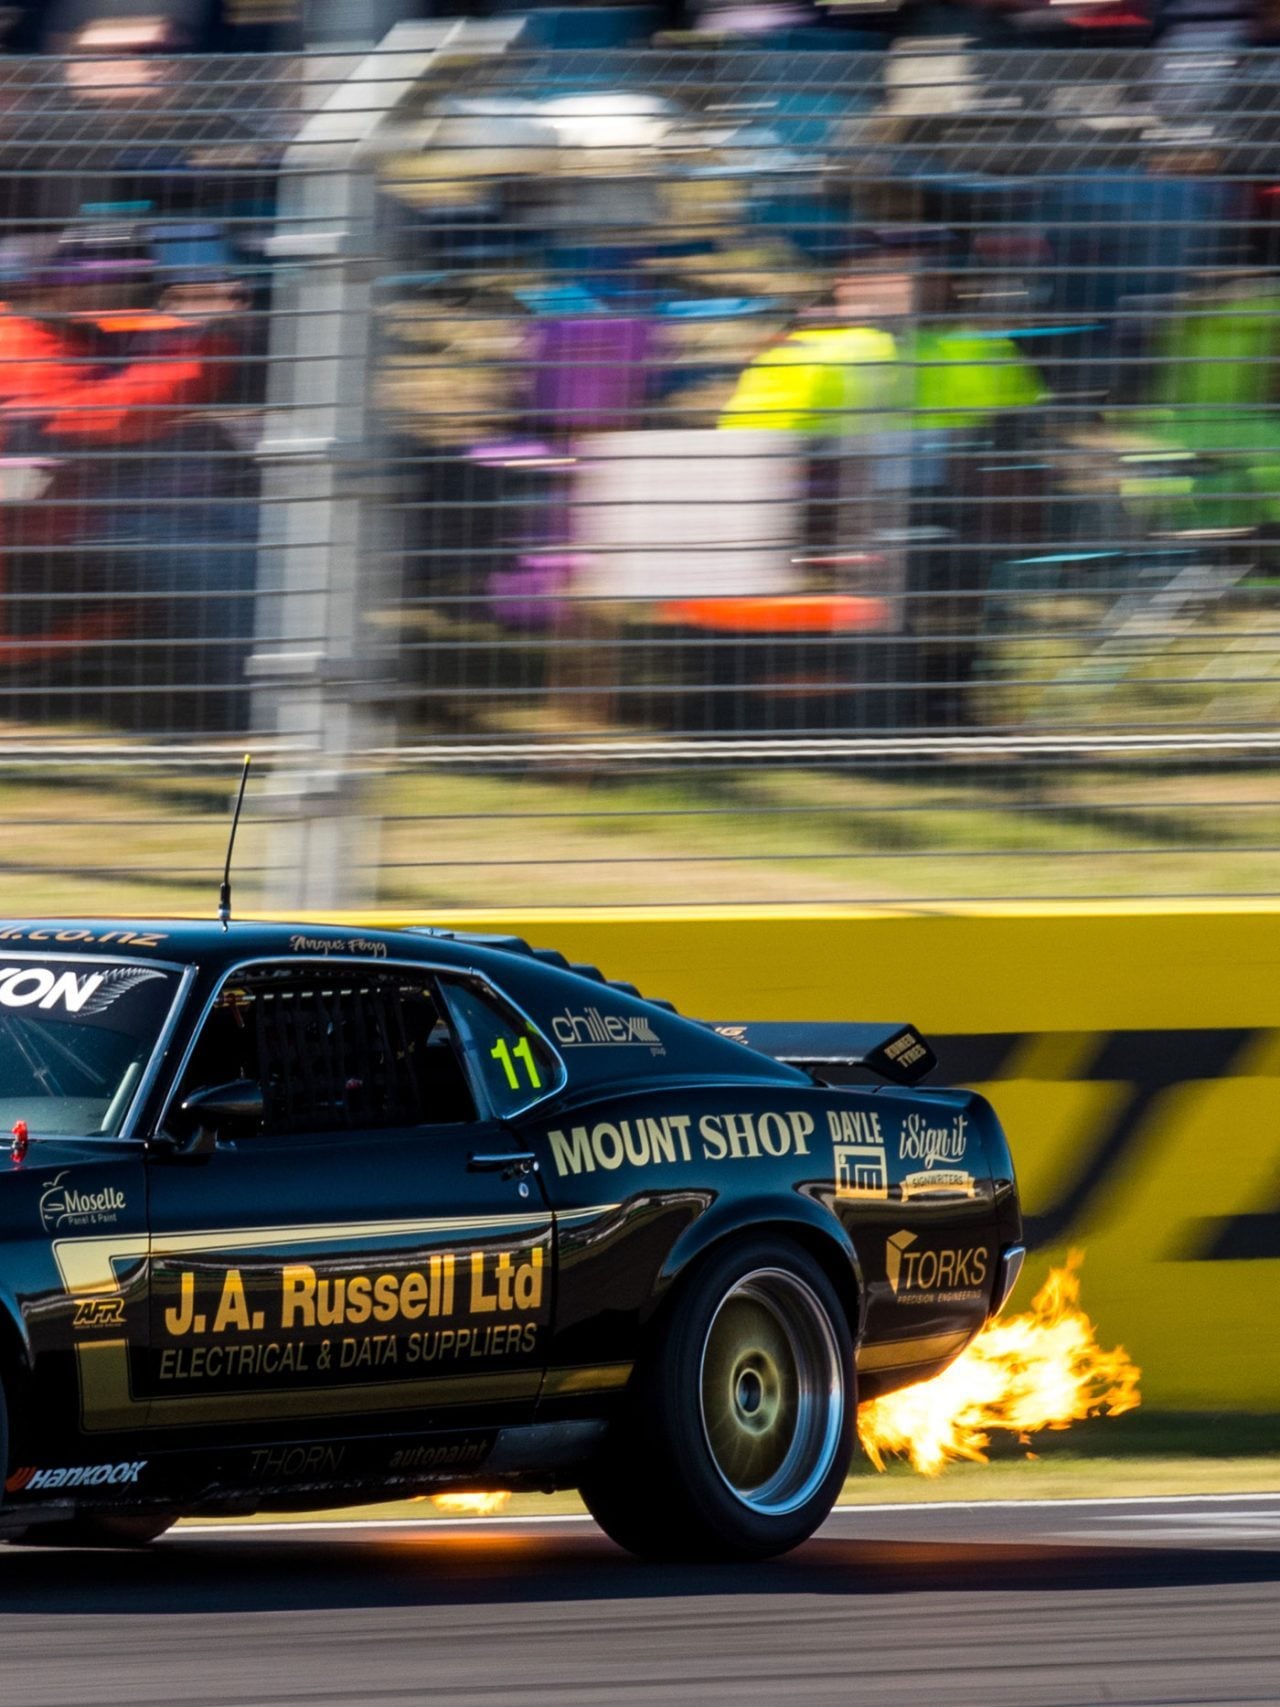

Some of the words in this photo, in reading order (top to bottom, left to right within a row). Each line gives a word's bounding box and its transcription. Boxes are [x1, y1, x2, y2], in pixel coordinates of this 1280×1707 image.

[289, 935, 345, 956] Angus
[348, 938, 388, 958] Fogg
[490, 1036, 542, 1090] 11
[897, 1044, 927, 1067] TYRES
[826, 1111, 884, 1143] DAYLE
[547, 1115, 692, 1177] MOUNT
[700, 1110, 815, 1161] SHOP
[64, 1187, 126, 1213] Moselle
[98, 1213, 117, 1223] Paint
[903, 1247, 988, 1290] TORKS
[282, 1255, 455, 1328] Russell
[469, 1247, 542, 1315] Ltd
[897, 1294, 934, 1305] PRECISION
[938, 1289, 982, 1303] ENGINEERING
[73, 1298, 127, 1325] AFR
[159, 1336, 308, 1380] ELECTRICAL
[316, 1337, 332, 1369] &
[341, 1333, 397, 1366] DATA
[405, 1322, 537, 1364] SUPPLIERS
[251, 1446, 345, 1475] THORN
[389, 1439, 488, 1468] autopaint
